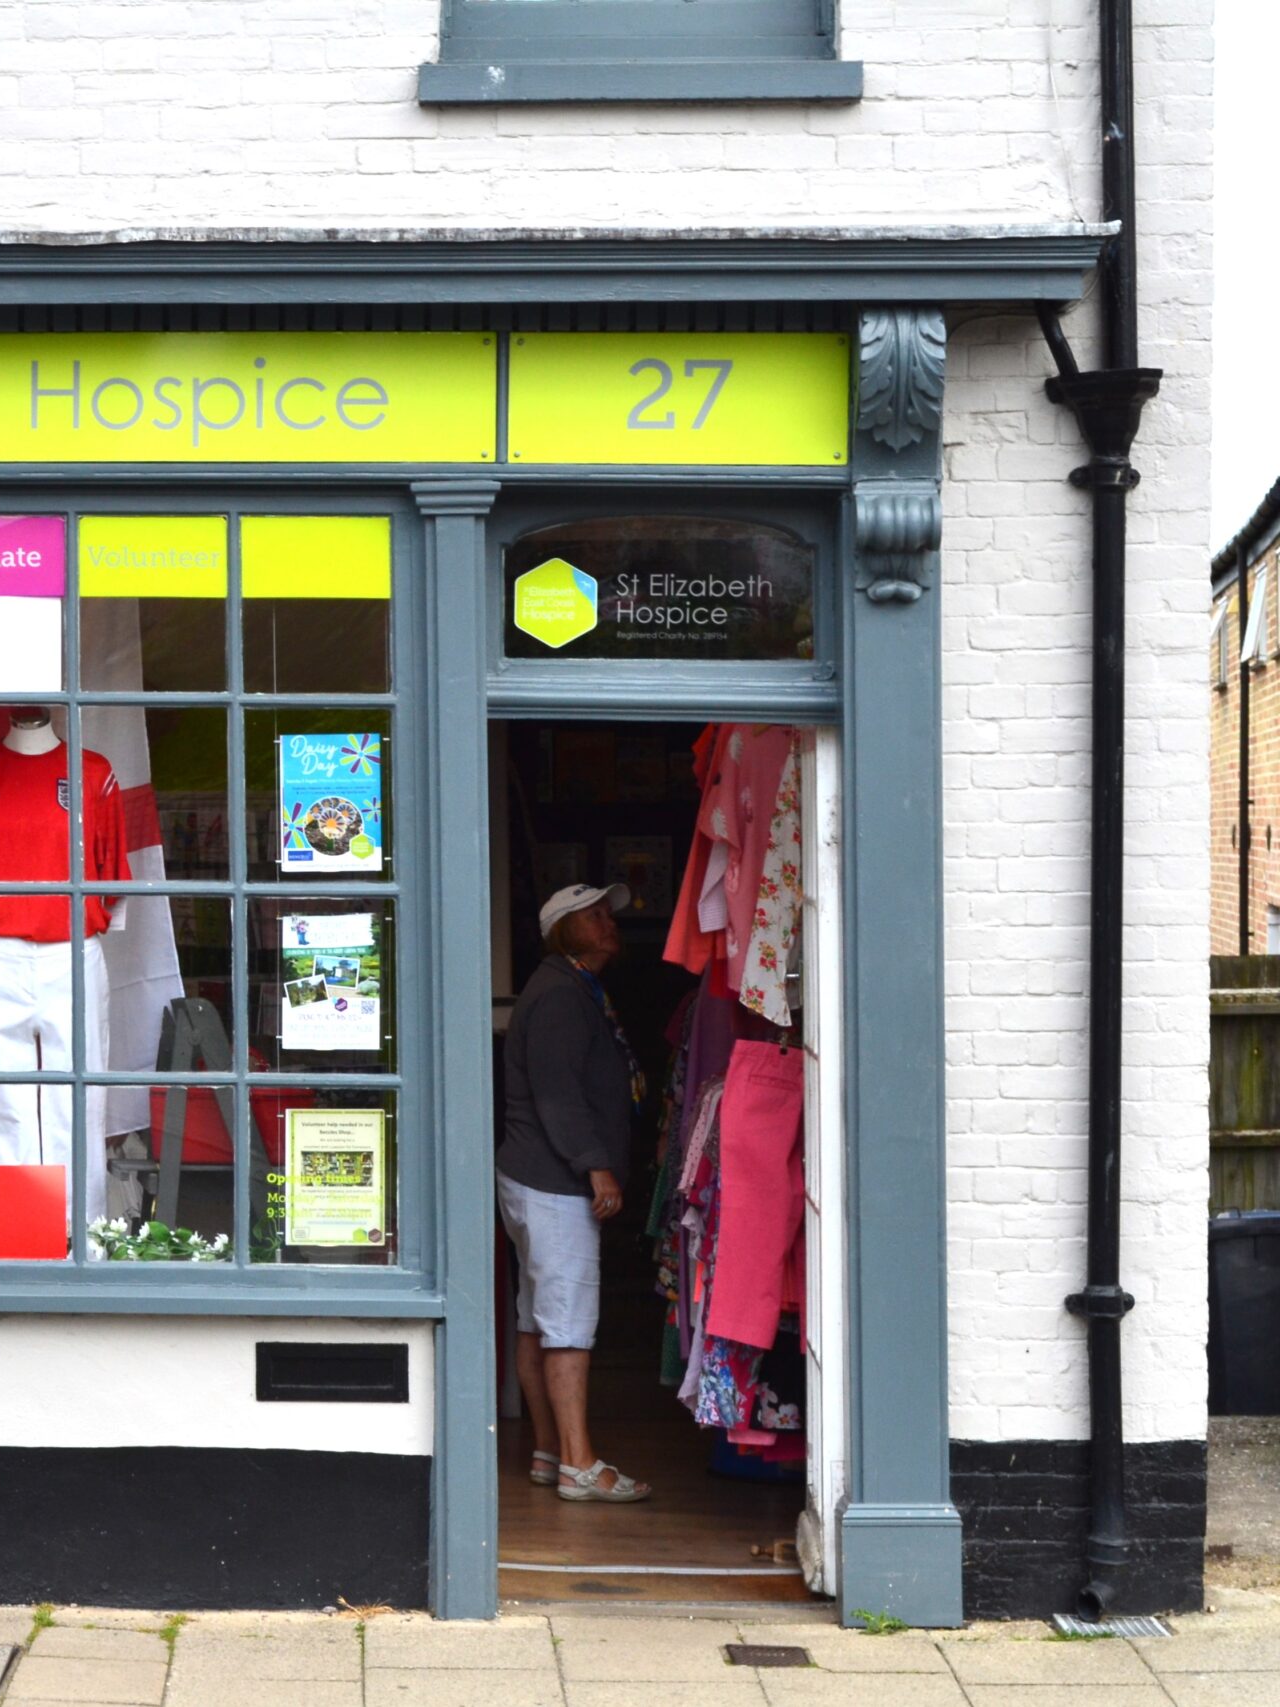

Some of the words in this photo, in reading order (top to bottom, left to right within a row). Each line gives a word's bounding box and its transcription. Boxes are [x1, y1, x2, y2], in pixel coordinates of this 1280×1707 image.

[30, 358, 391, 448] Hospice
[625, 359, 734, 431] 27
[87, 545, 220, 570] Volunteer
[616, 573, 639, 598] St
[650, 573, 773, 598] Elizabeth
[617, 601, 728, 629] Hospice
[302, 754, 339, 778] Day
